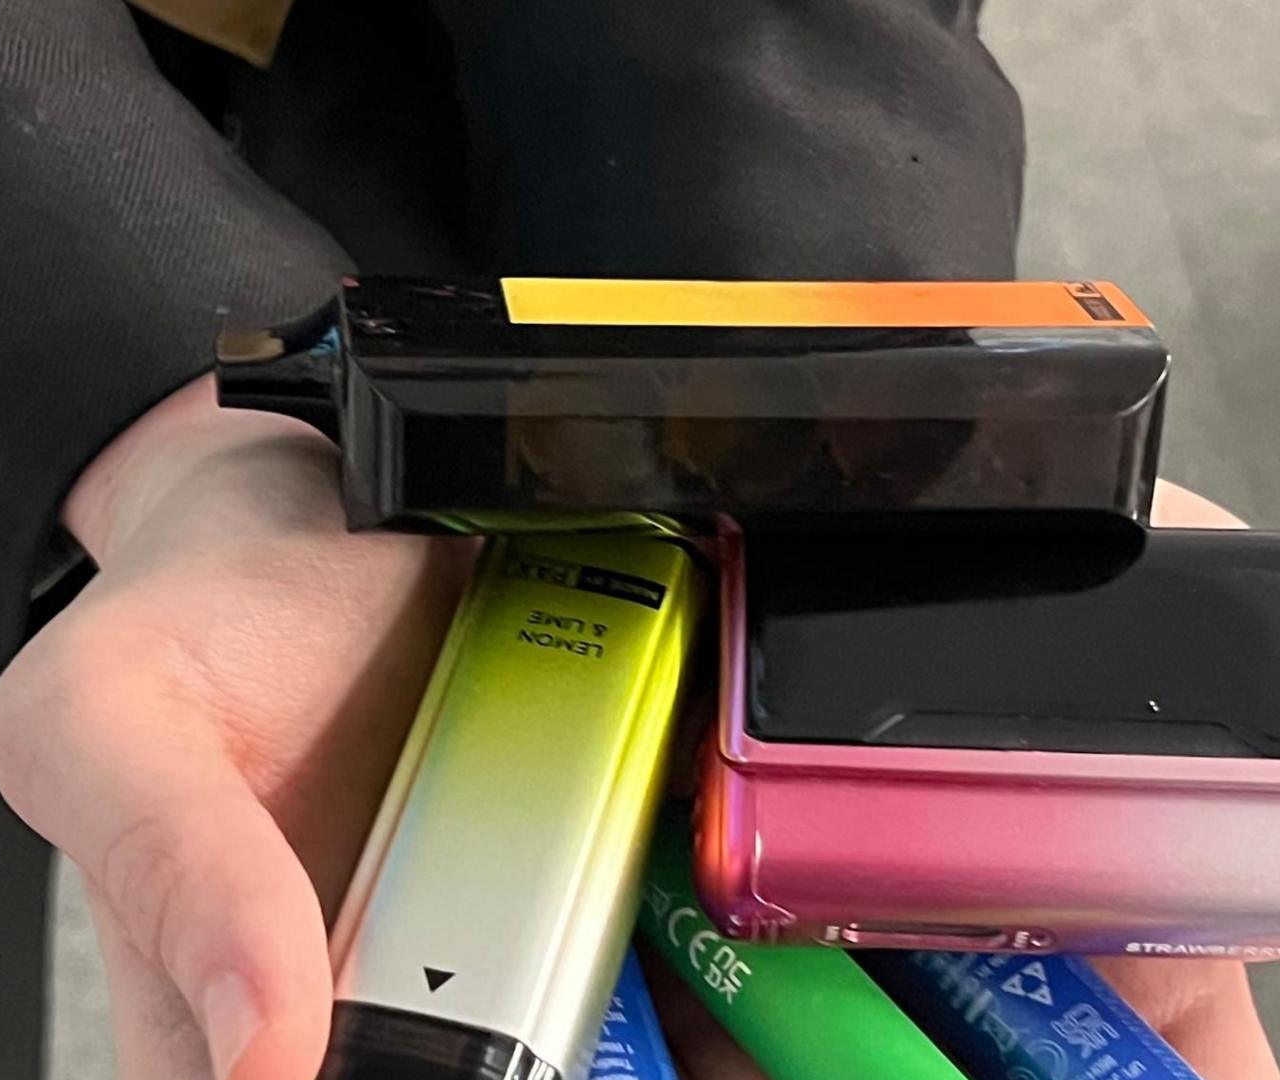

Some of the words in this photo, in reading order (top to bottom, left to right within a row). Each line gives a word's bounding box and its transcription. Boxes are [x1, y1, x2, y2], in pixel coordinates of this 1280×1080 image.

[526, 610, 586, 635] LIME
[591, 623, 608, 638] &
[518, 628, 605, 658] LEMON
